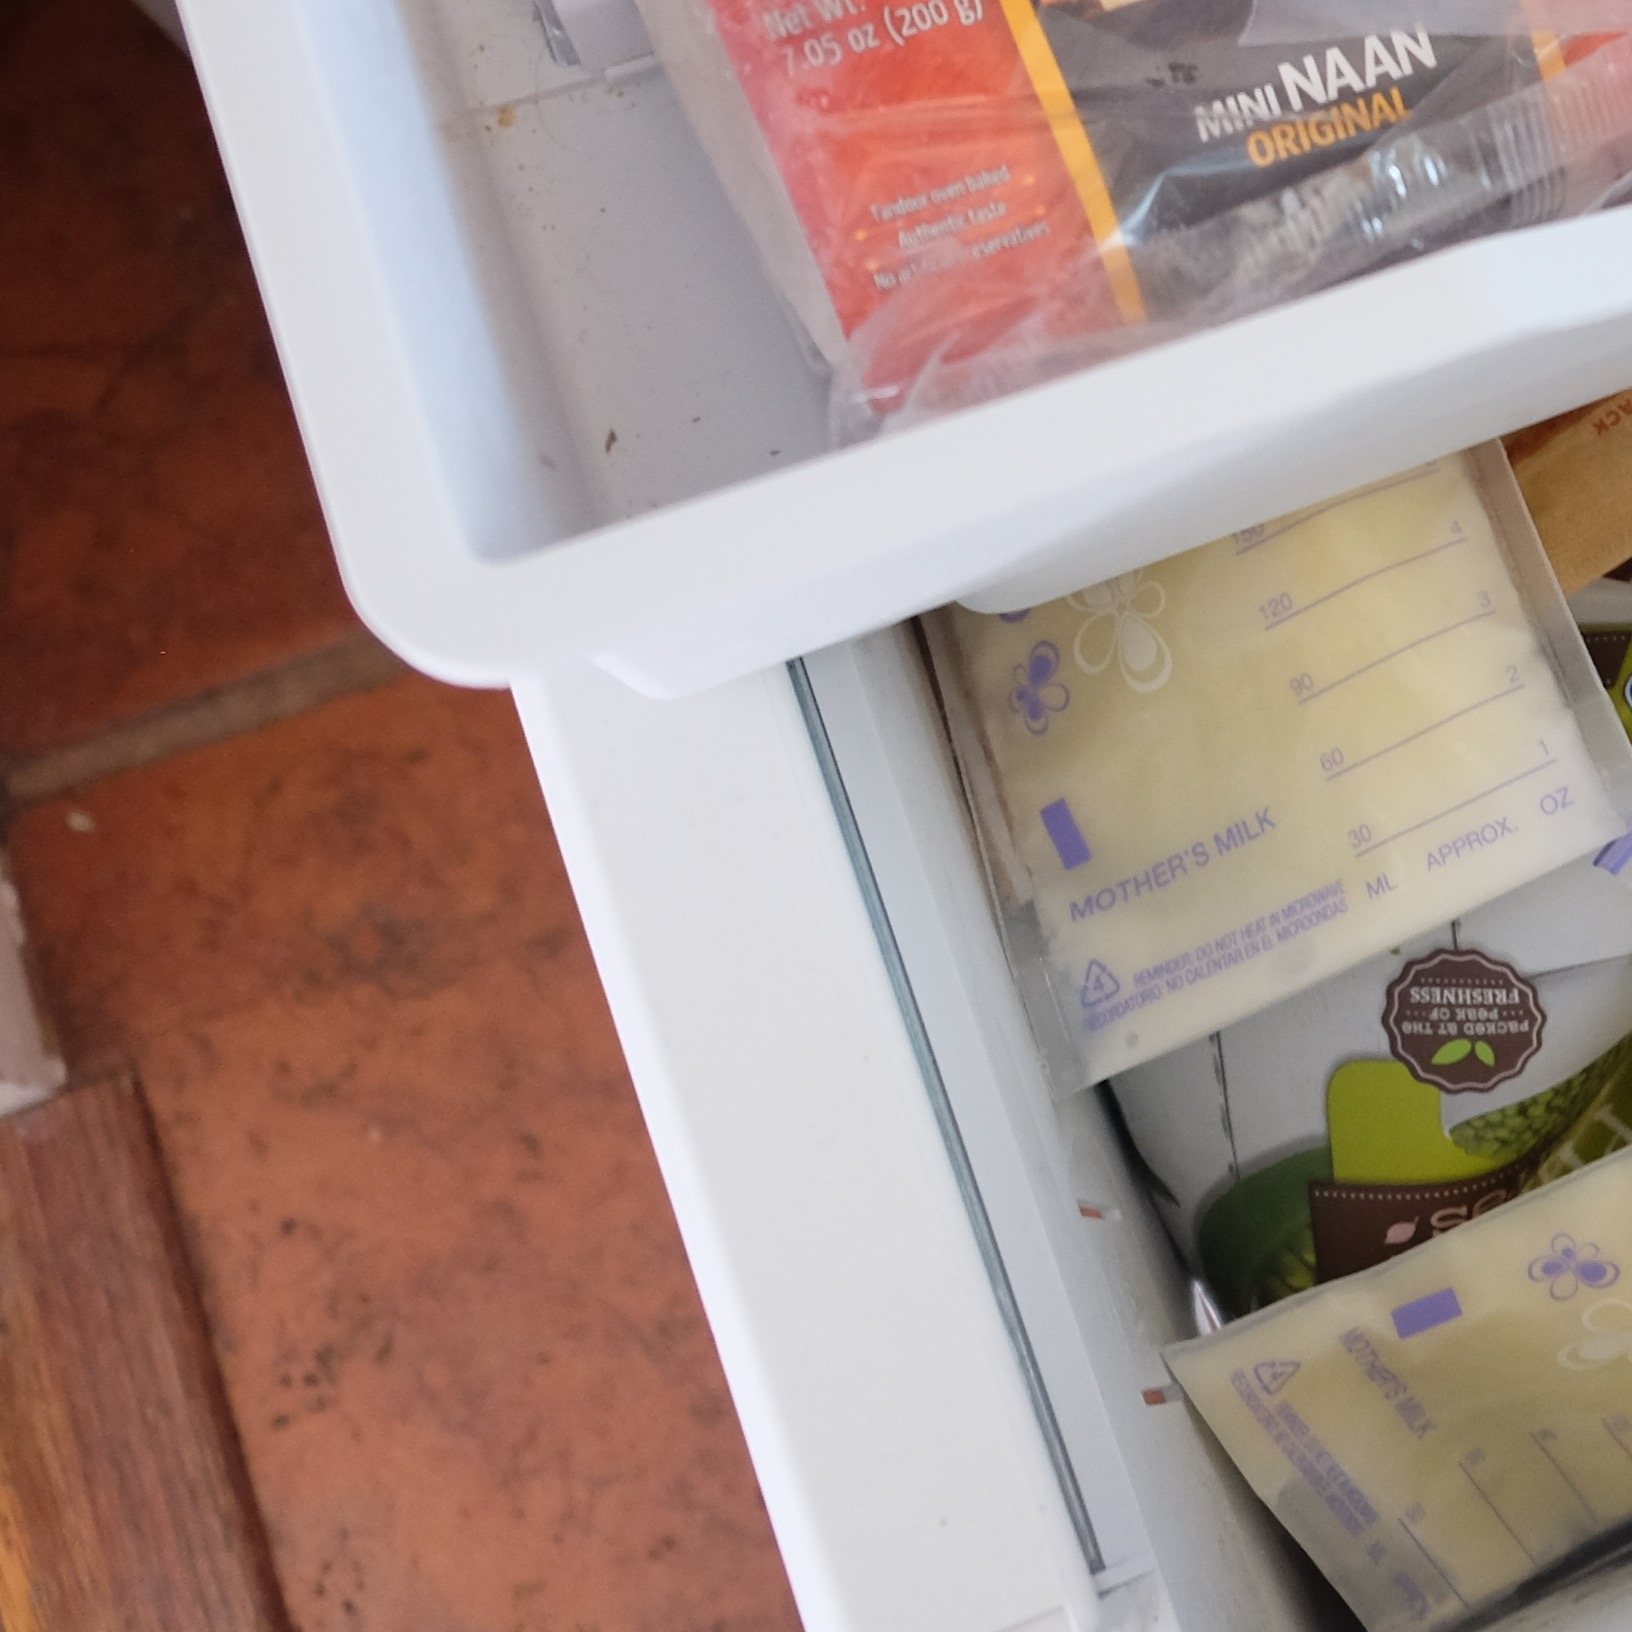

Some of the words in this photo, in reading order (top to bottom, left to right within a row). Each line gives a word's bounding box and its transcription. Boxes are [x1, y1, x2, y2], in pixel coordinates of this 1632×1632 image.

[763, 4, 814, 41] Net
[848, 21, 881, 55] oz
[1194, 82, 1281, 145] MINI
[1278, 26, 1440, 112] NAAN
[1246, 86, 1415, 169] ORIGINAL
[1450, 520, 1465, 537] 4
[1258, 591, 1295, 622] 120
[1479, 592, 1493, 610] 3
[1290, 671, 1317, 697] 90
[1506, 665, 1520, 684] 2
[1319, 746, 1346, 772] 60
[1347, 823, 1374, 851] 30
[1364, 870, 1400, 902] ML
[1424, 818, 1520, 872] APPROX.
[1538, 784, 1576, 817] OZ
[1069, 840, 1212, 923] MOTHER'S
[1213, 806, 1278, 857] MILK
[1409, 985, 1521, 1006] FRESHNESS
[1428, 1006, 1451, 1021] OF
